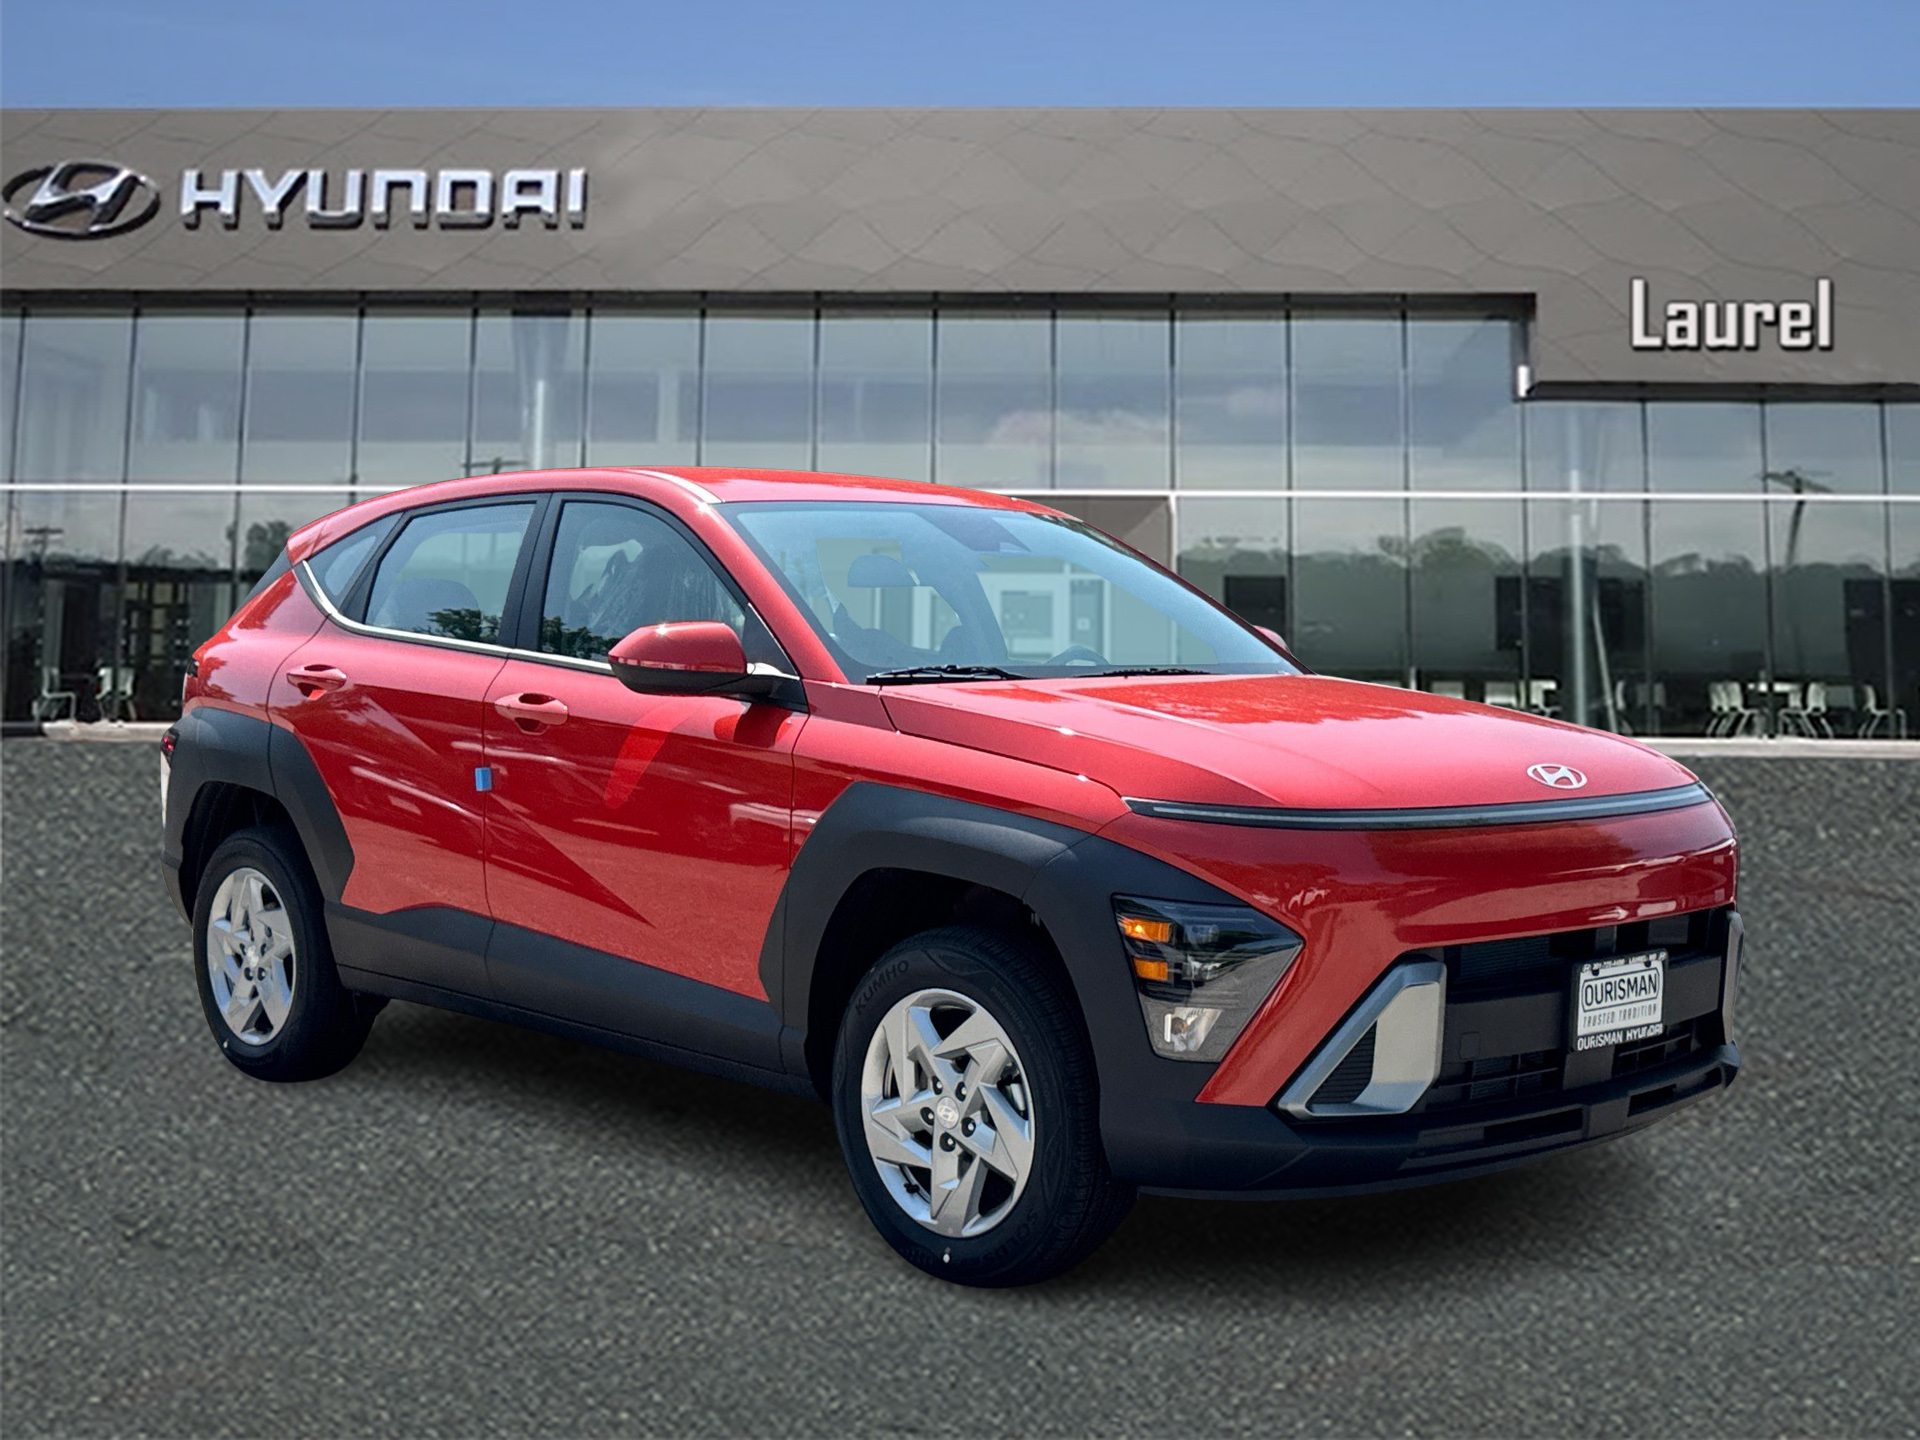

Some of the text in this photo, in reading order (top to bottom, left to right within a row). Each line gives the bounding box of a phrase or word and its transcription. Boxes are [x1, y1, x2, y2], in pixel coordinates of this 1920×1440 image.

[180, 167, 587, 229] HYUNDAI
[1630, 277, 1833, 350] Laurel
[855, 960, 909, 1015] KUMHO
[1585, 973, 1657, 1006] OURISMAN
[1583, 1004, 1657, 1028] TRUSTED TRADITION
[1577, 1030, 1623, 1051] OURISMAN
